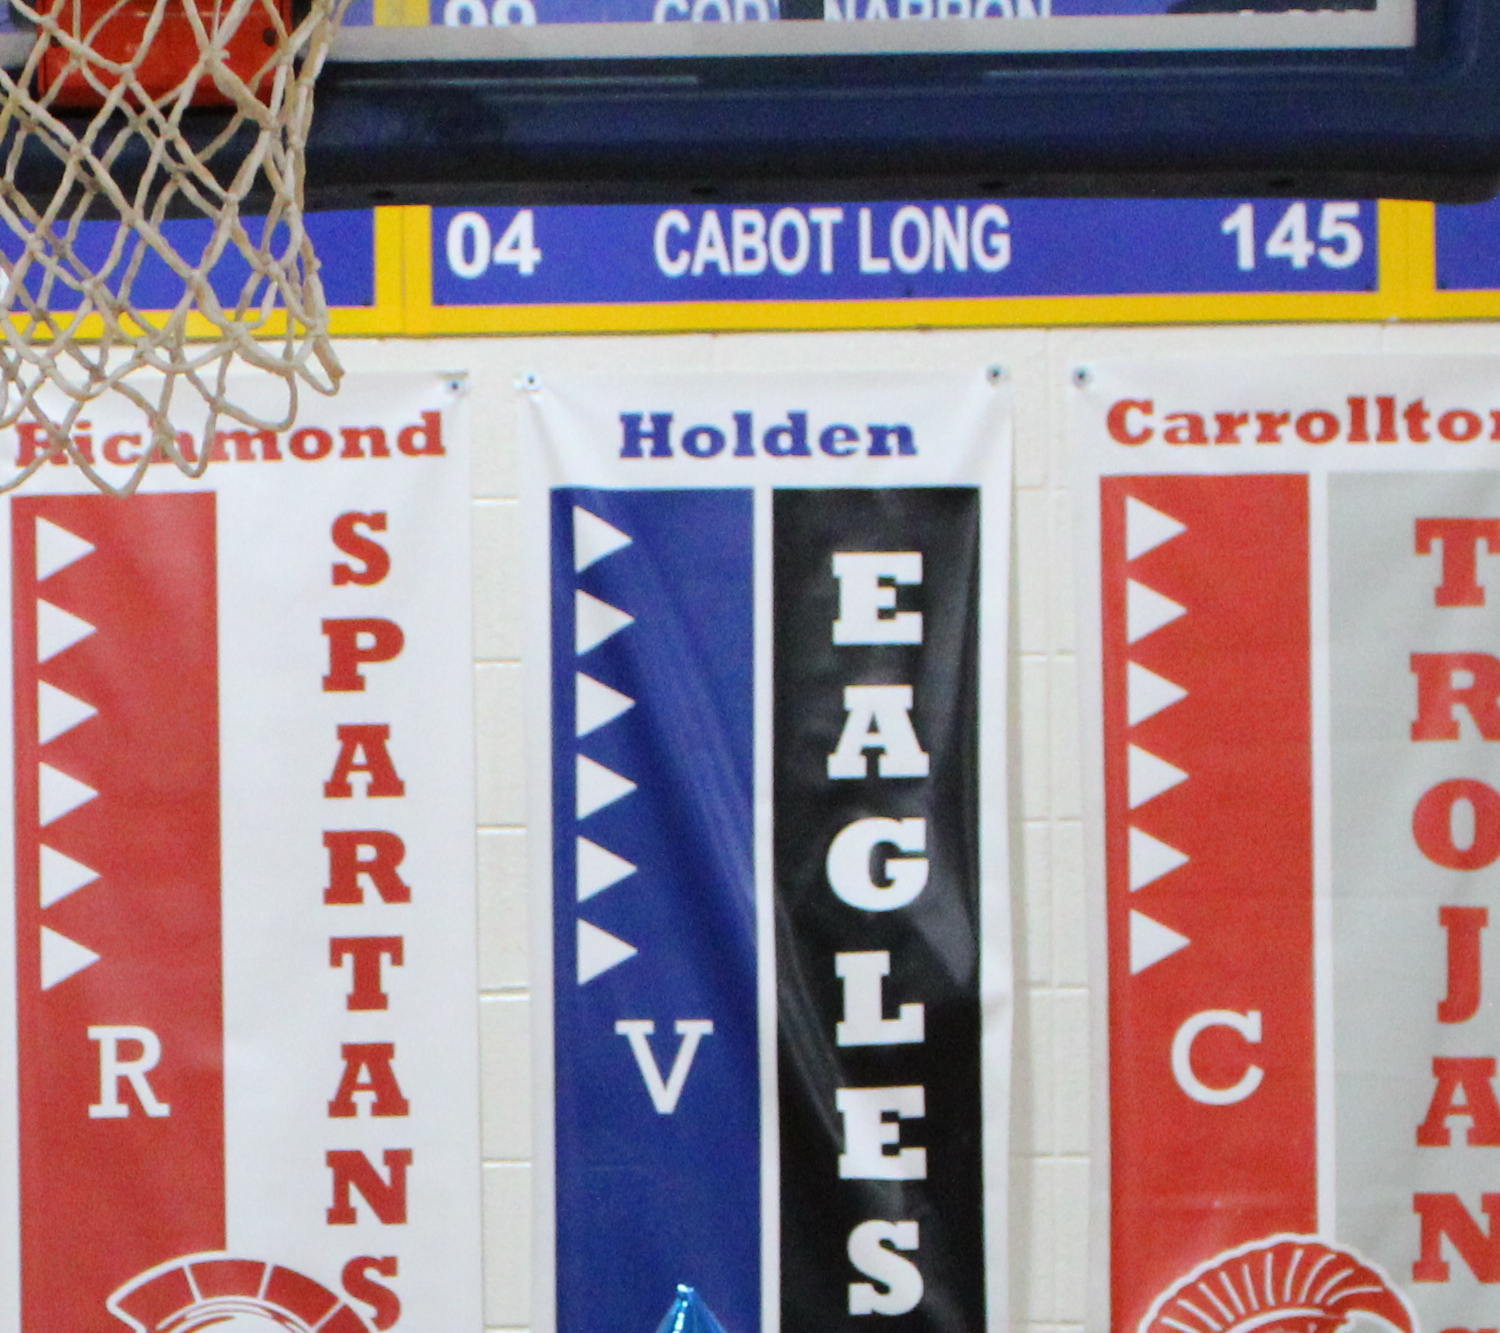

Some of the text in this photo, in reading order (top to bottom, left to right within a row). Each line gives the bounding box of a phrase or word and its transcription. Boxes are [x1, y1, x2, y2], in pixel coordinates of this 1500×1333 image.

[446, 202, 1364, 280] 04 CABOT LONG 145
[13, 409, 448, 469] Richmond
[617, 409, 920, 461] Holden
[320, 510, 414, 1333] SPARTANS
[825, 551, 931, 1317] EAGLES
[86, 1024, 171, 1120] R
[614, 1019, 714, 1115] V
[1170, 1009, 1266, 1106] C
